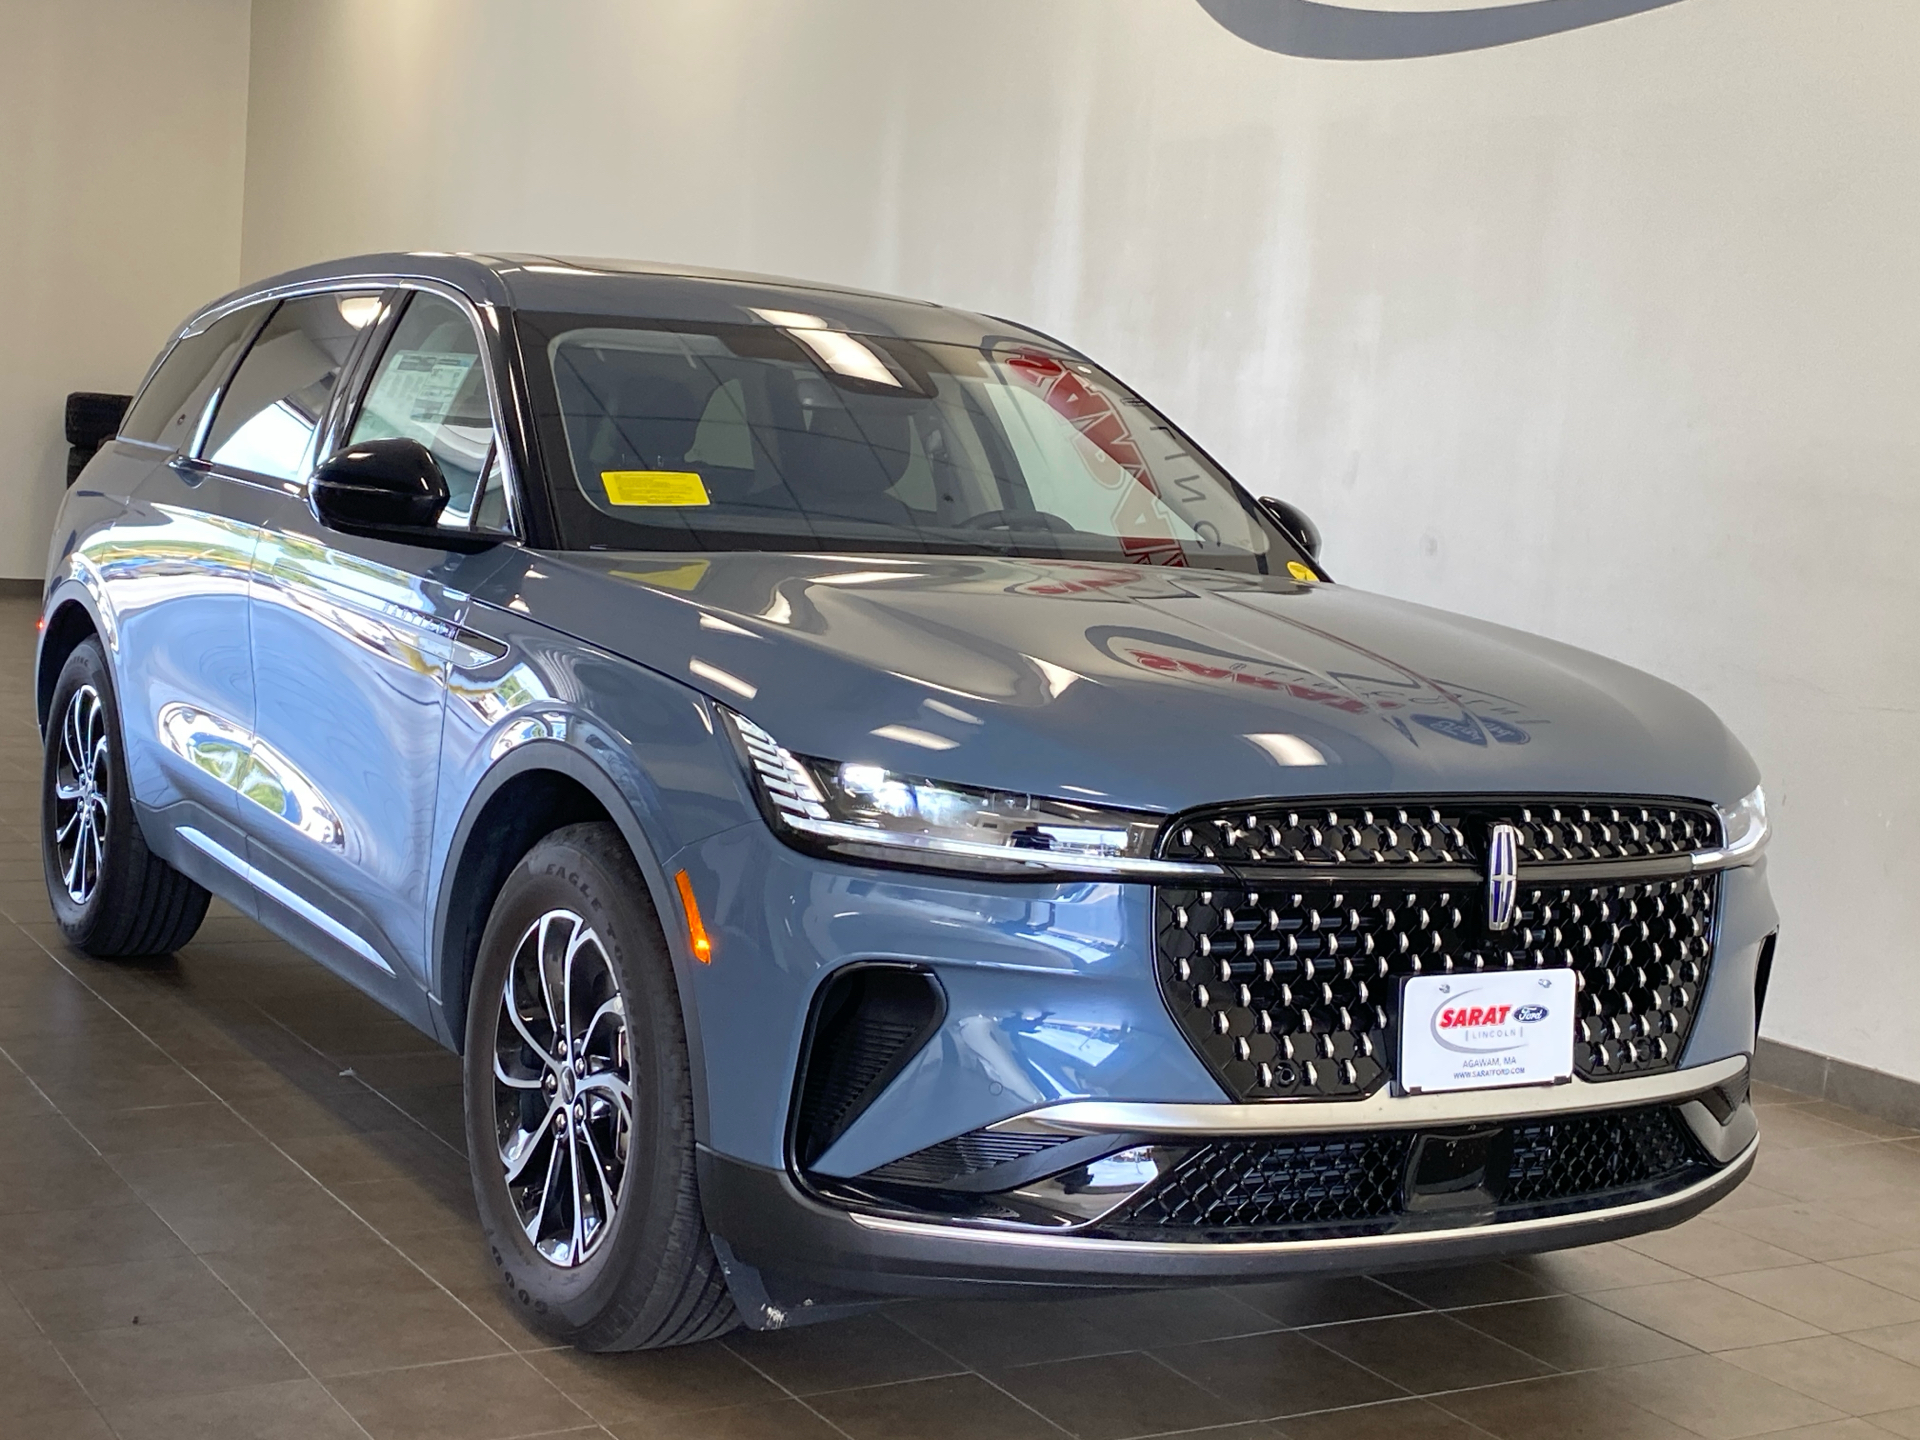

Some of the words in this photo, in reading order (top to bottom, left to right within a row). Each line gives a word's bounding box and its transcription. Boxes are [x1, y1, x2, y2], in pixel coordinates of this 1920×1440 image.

[545, 863, 602, 912] EAGLE
[1439, 1005, 1512, 1029] SARAT
[1472, 1029, 1516, 1039] LINCOLN
[1463, 1058, 1501, 1068] AGAWAM,
[1504, 1057, 1517, 1065] MA
[1453, 1067, 1525, 1079] WWW.SARATFORD.COM
